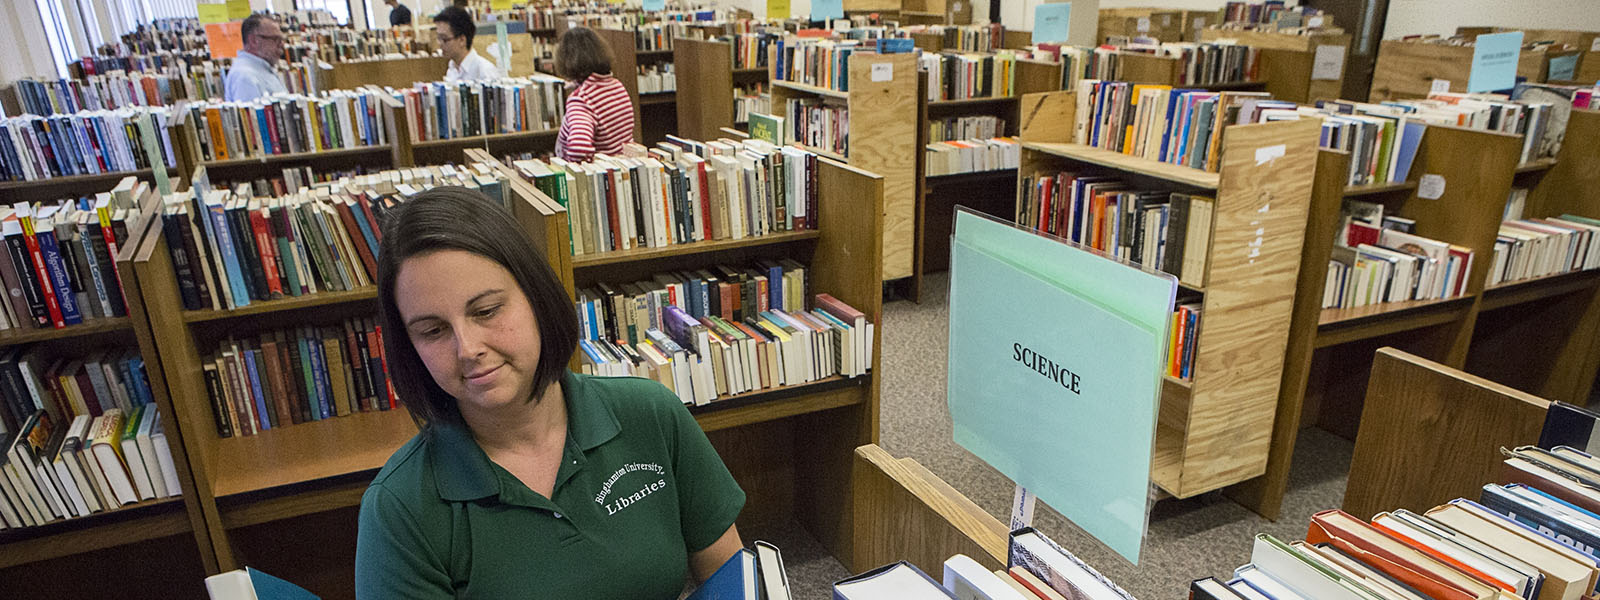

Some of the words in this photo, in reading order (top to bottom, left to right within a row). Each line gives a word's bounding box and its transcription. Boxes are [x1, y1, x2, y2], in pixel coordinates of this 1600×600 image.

[47, 250, 65, 287] Algorithm
[60, 287, 74, 313] Design
[1013, 342, 1081, 395] SCIENCE
[595, 467, 627, 505] Binghamton
[605, 479, 666, 516] Libraries
